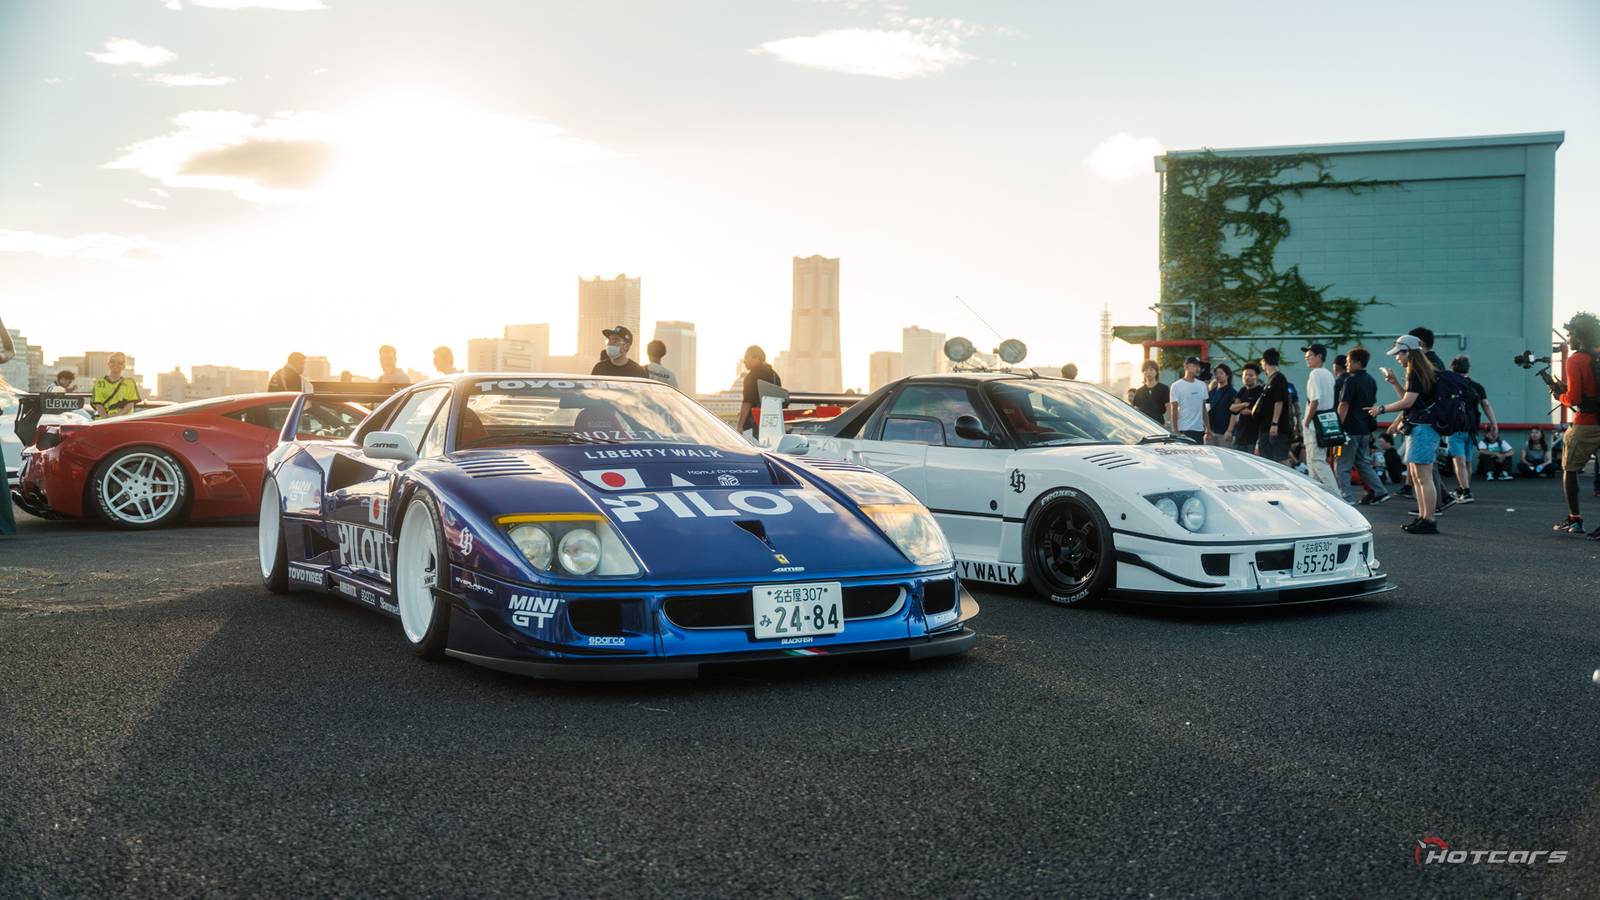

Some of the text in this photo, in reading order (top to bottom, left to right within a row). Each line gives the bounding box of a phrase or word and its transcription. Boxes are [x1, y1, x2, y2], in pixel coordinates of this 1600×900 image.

[475, 379, 575, 391] TOYO
[45, 399, 79, 409] LBWK
[584, 449, 724, 459] LIBERTY WALK
[600, 490, 835, 523] PILOT
[973, 562, 1018, 583] WALK
[1303, 553, 1336, 574] 55-29
[508, 594, 559, 613] MINI
[512, 610, 554, 629] GT
[760, 603, 839, 633] み 24-84
[588, 636, 625, 645] sparco
